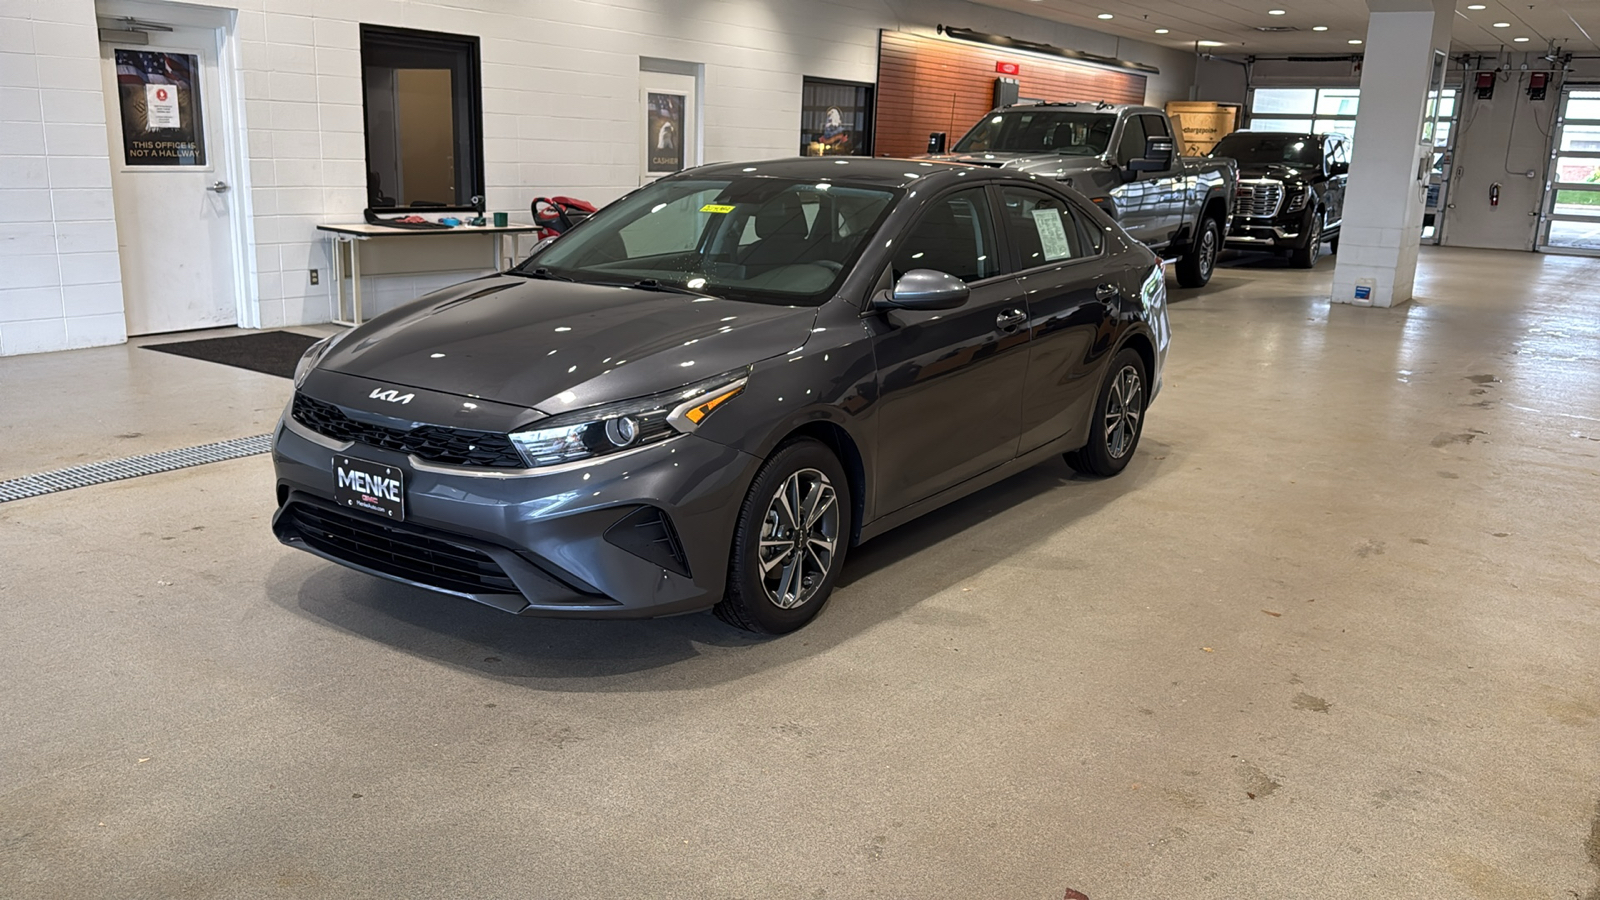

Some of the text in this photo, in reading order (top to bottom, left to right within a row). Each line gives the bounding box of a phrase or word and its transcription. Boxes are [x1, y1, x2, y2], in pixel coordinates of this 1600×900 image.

[133, 141, 197, 150] THIS OFFICE IS
[129, 149, 200, 158] NOT A HALLWAY
[652, 157, 679, 165] CASHIER
[337, 466, 400, 503] MENKE
